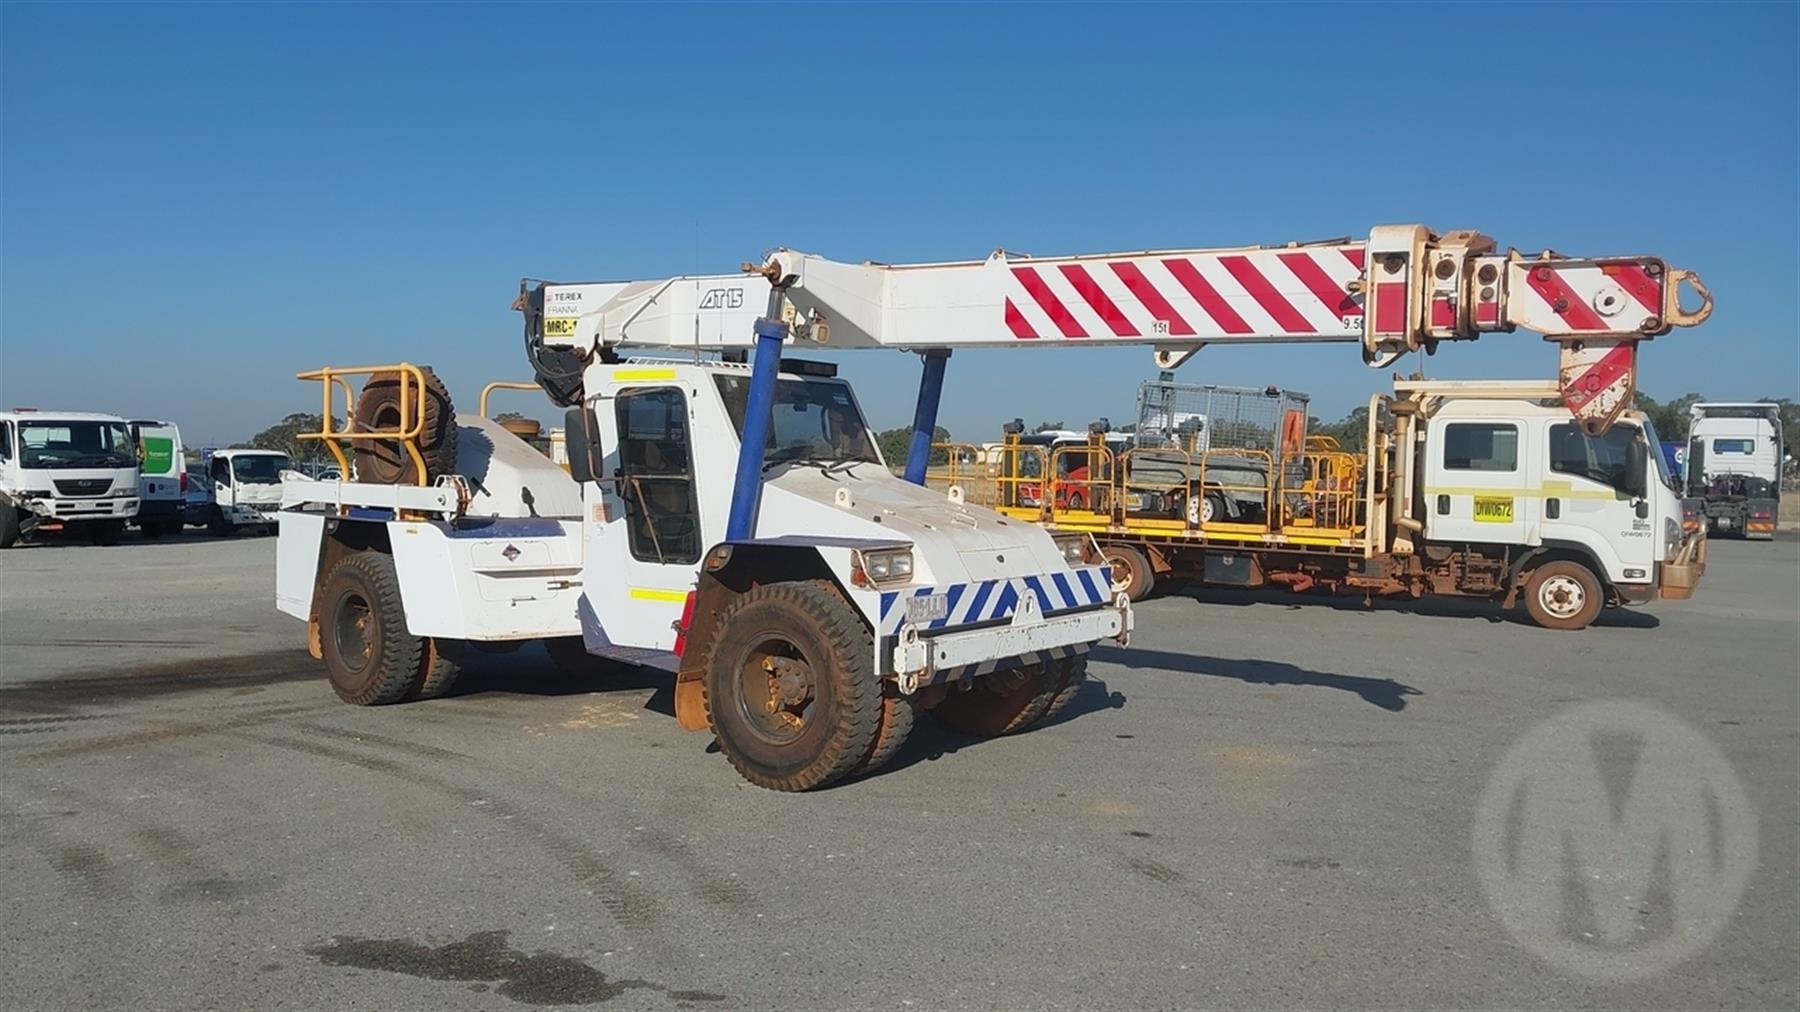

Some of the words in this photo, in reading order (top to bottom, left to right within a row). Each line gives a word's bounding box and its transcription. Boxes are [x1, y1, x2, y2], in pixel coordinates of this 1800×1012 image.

[555, 293, 582, 301] TEREX
[547, 305, 578, 313] FRANNA
[1153, 322, 1167, 333] 15t
